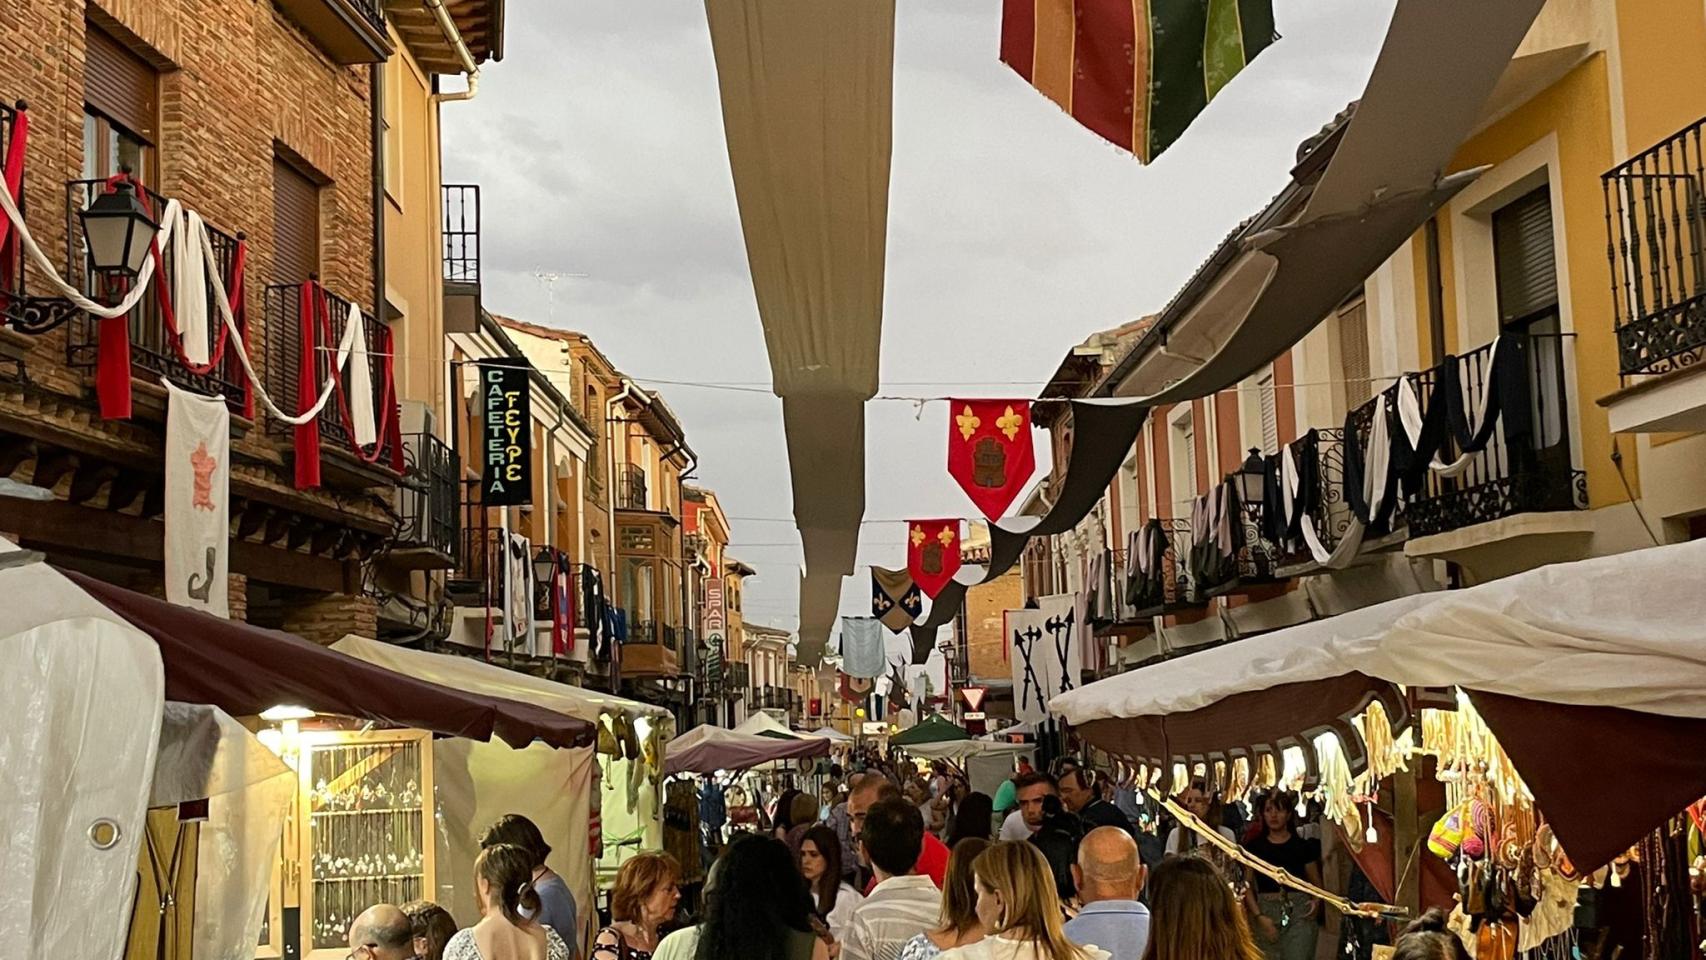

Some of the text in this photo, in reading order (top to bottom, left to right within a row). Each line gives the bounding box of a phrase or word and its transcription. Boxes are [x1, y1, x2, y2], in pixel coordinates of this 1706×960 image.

[487, 370, 504, 493] CAFETERIA
[505, 391, 522, 481] FEYPE
[708, 588, 722, 629] SPAR
